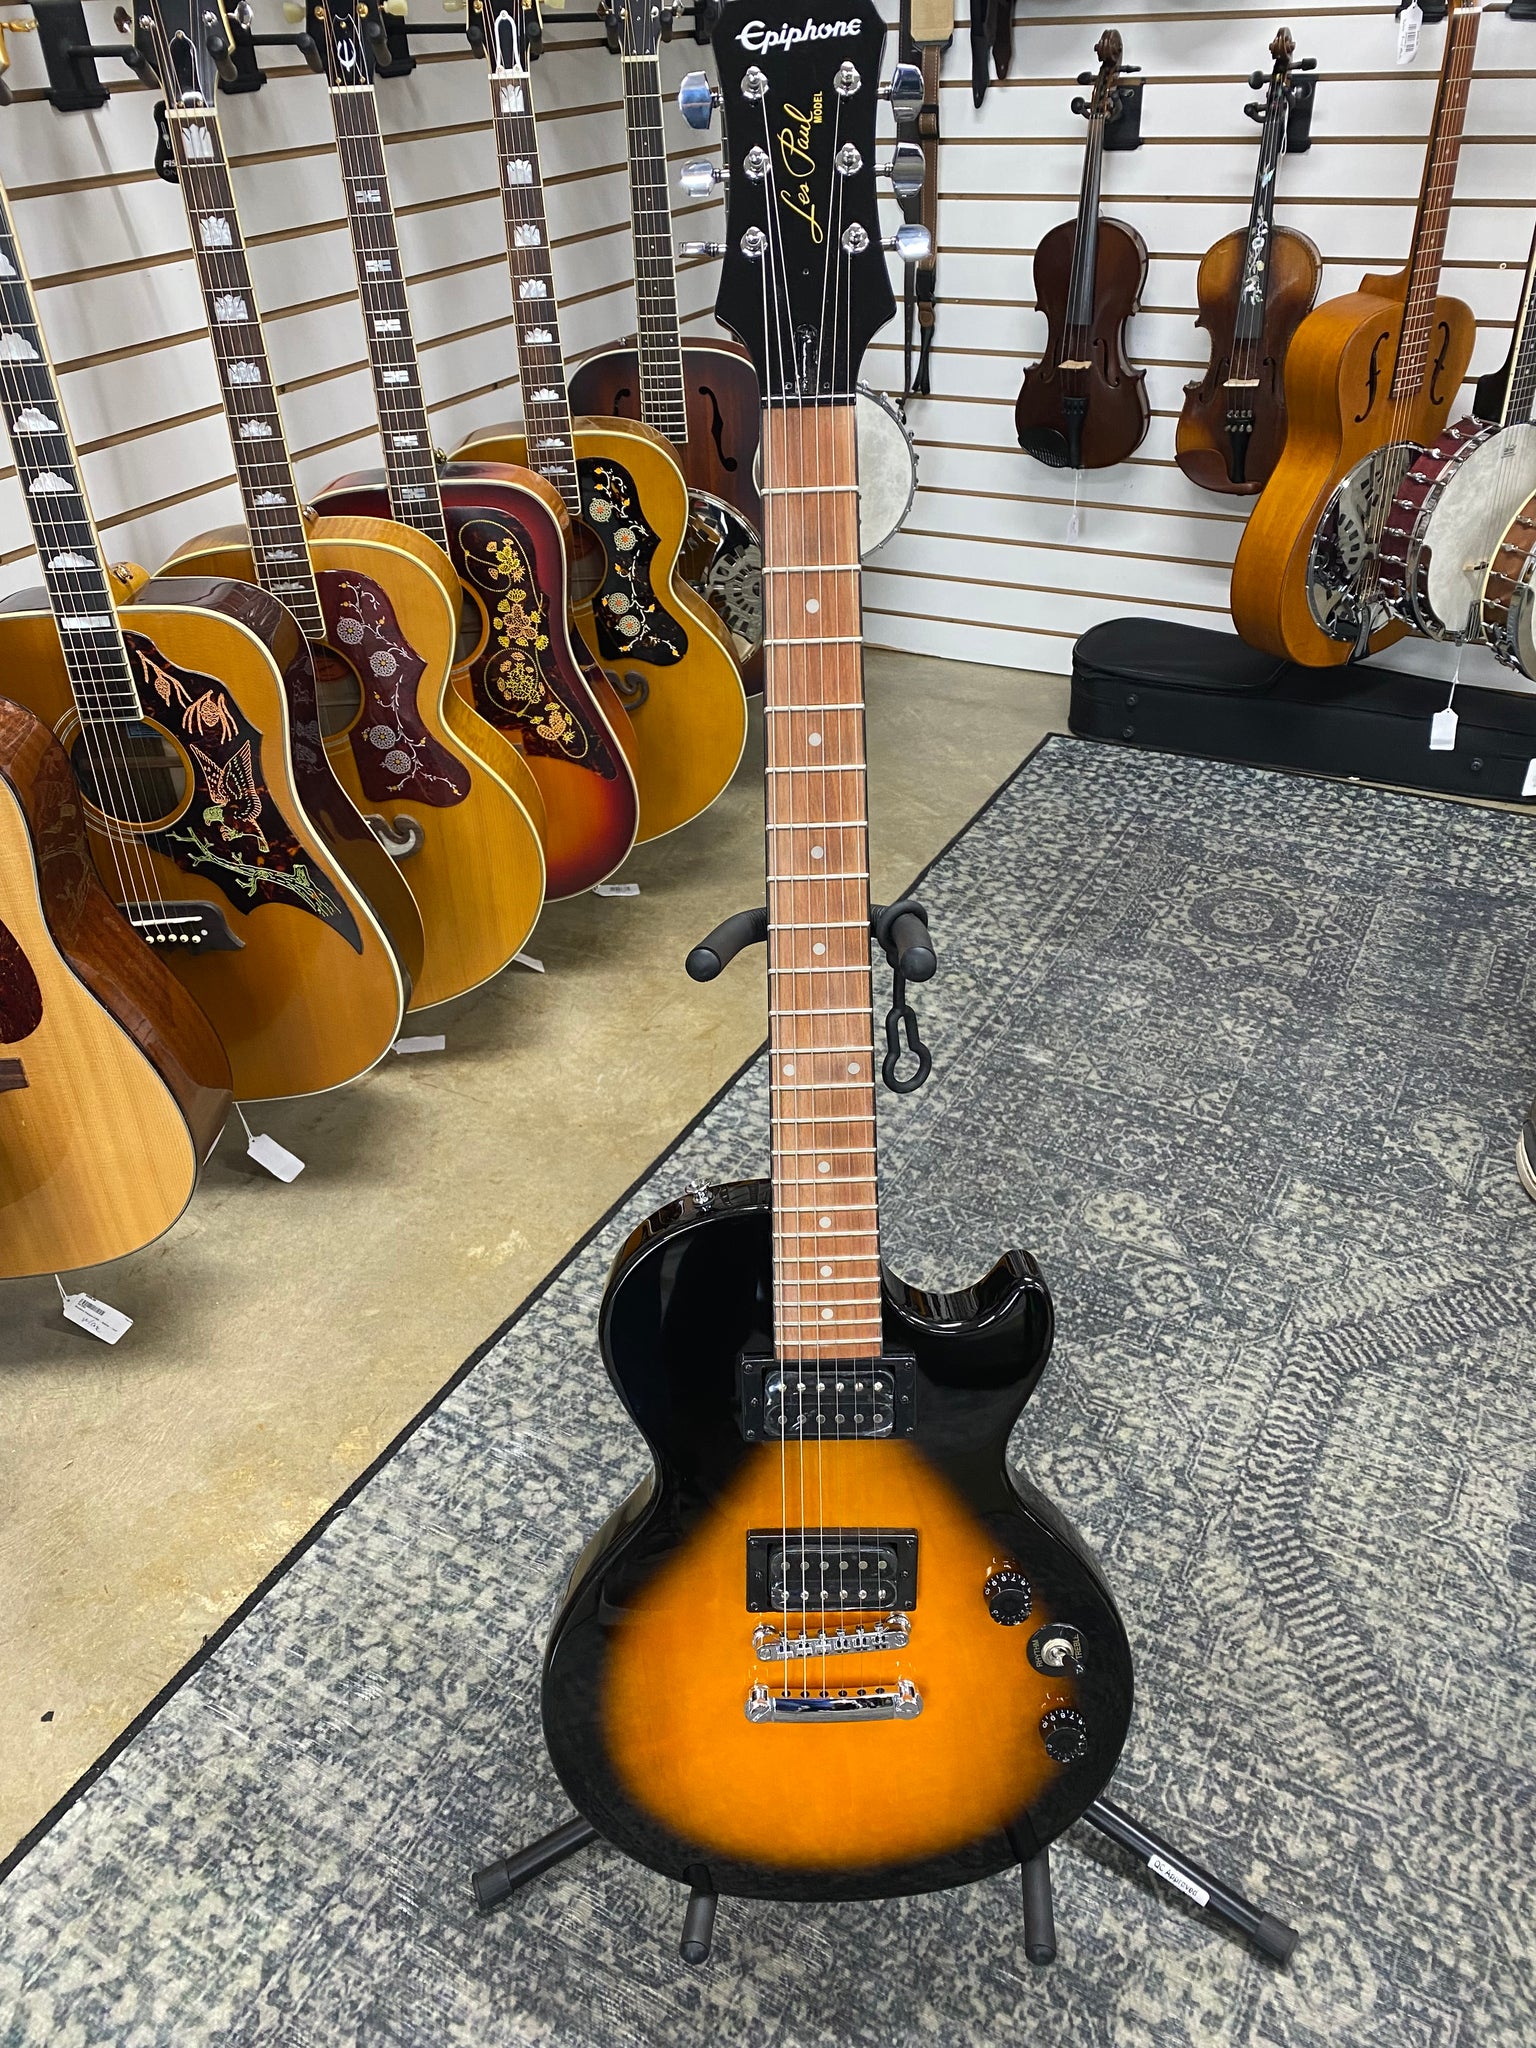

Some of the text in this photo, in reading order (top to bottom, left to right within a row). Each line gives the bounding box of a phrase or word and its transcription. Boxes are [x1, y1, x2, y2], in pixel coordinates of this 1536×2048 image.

[735, 18, 862, 55] Epiphone
[813, 91, 823, 124] MODEL
[777, 103, 824, 244] Les Paul
[1031, 1639, 1044, 1668] RHYTHM
[1072, 1633, 1083, 1660] TREBLE
[1153, 1859, 1198, 1897] QC Approved
